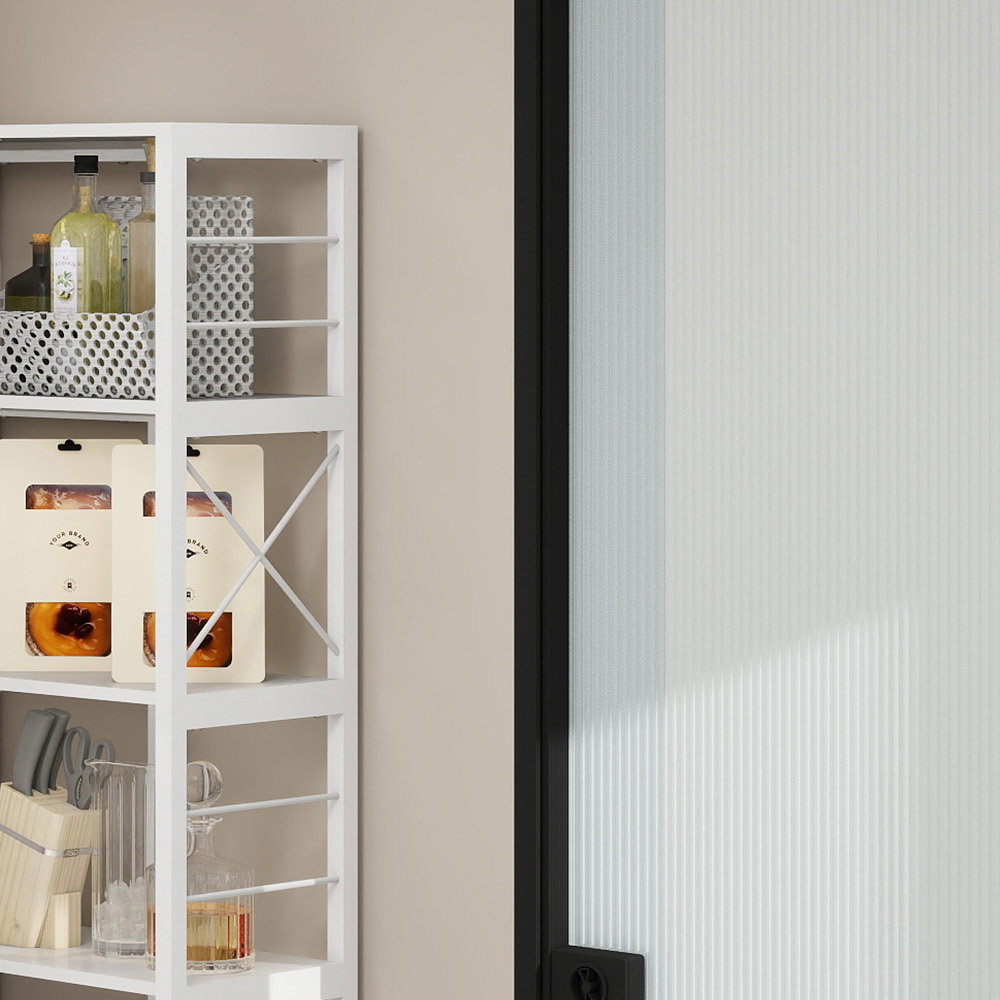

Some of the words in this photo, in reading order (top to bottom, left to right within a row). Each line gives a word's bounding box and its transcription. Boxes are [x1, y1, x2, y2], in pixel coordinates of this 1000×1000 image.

[49, 531, 66, 545] YOUR
[68, 530, 90, 546] BRAND
[187, 538, 209, 555] BRAND
